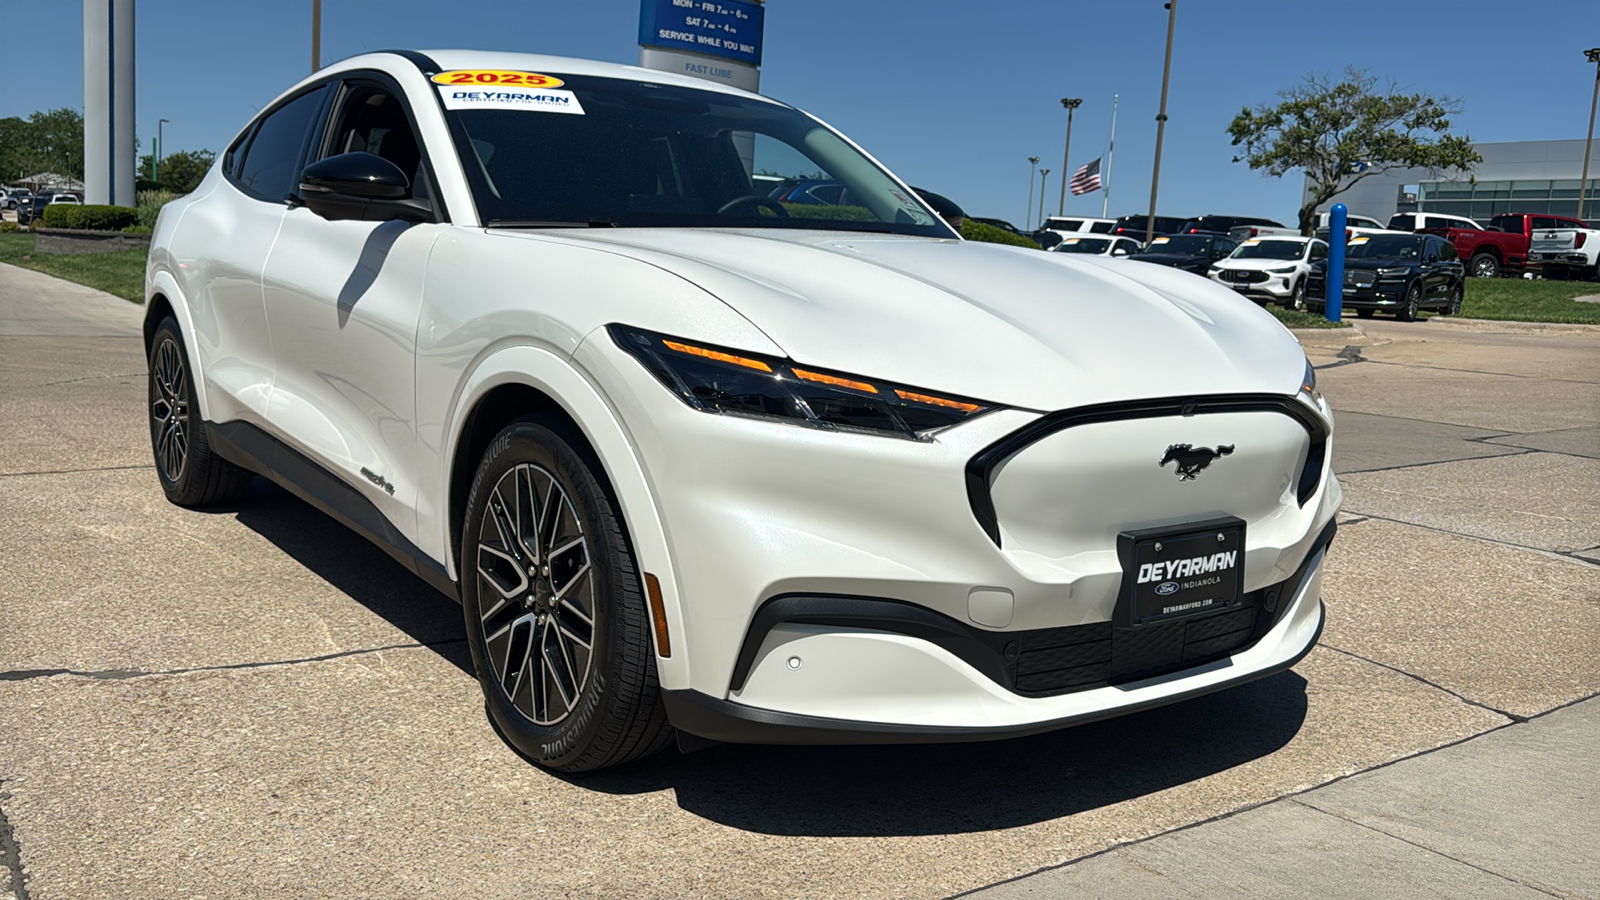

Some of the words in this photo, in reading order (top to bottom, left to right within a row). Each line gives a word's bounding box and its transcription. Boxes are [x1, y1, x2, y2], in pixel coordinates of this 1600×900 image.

[672, 0, 693, 9] MON
[702, 2, 715, 13] FRI
[685, 16, 702, 27] SAT
[659, 28, 695, 43] SERVICE
[697, 35, 721, 48] WHILE
[723, 40, 738, 51] YOU
[739, 44, 755, 54] WAIT
[685, 62, 709, 75] FAST
[710, 68, 733, 79] LUBE
[449, 73, 549, 85] 2025
[452, 91, 569, 104] DEYARMAN
[1136, 550, 1237, 584] DEYARMAN
[1181, 576, 1221, 590] INDIANOLA
[1163, 598, 1213, 614] DEYARMANFORD.COM
